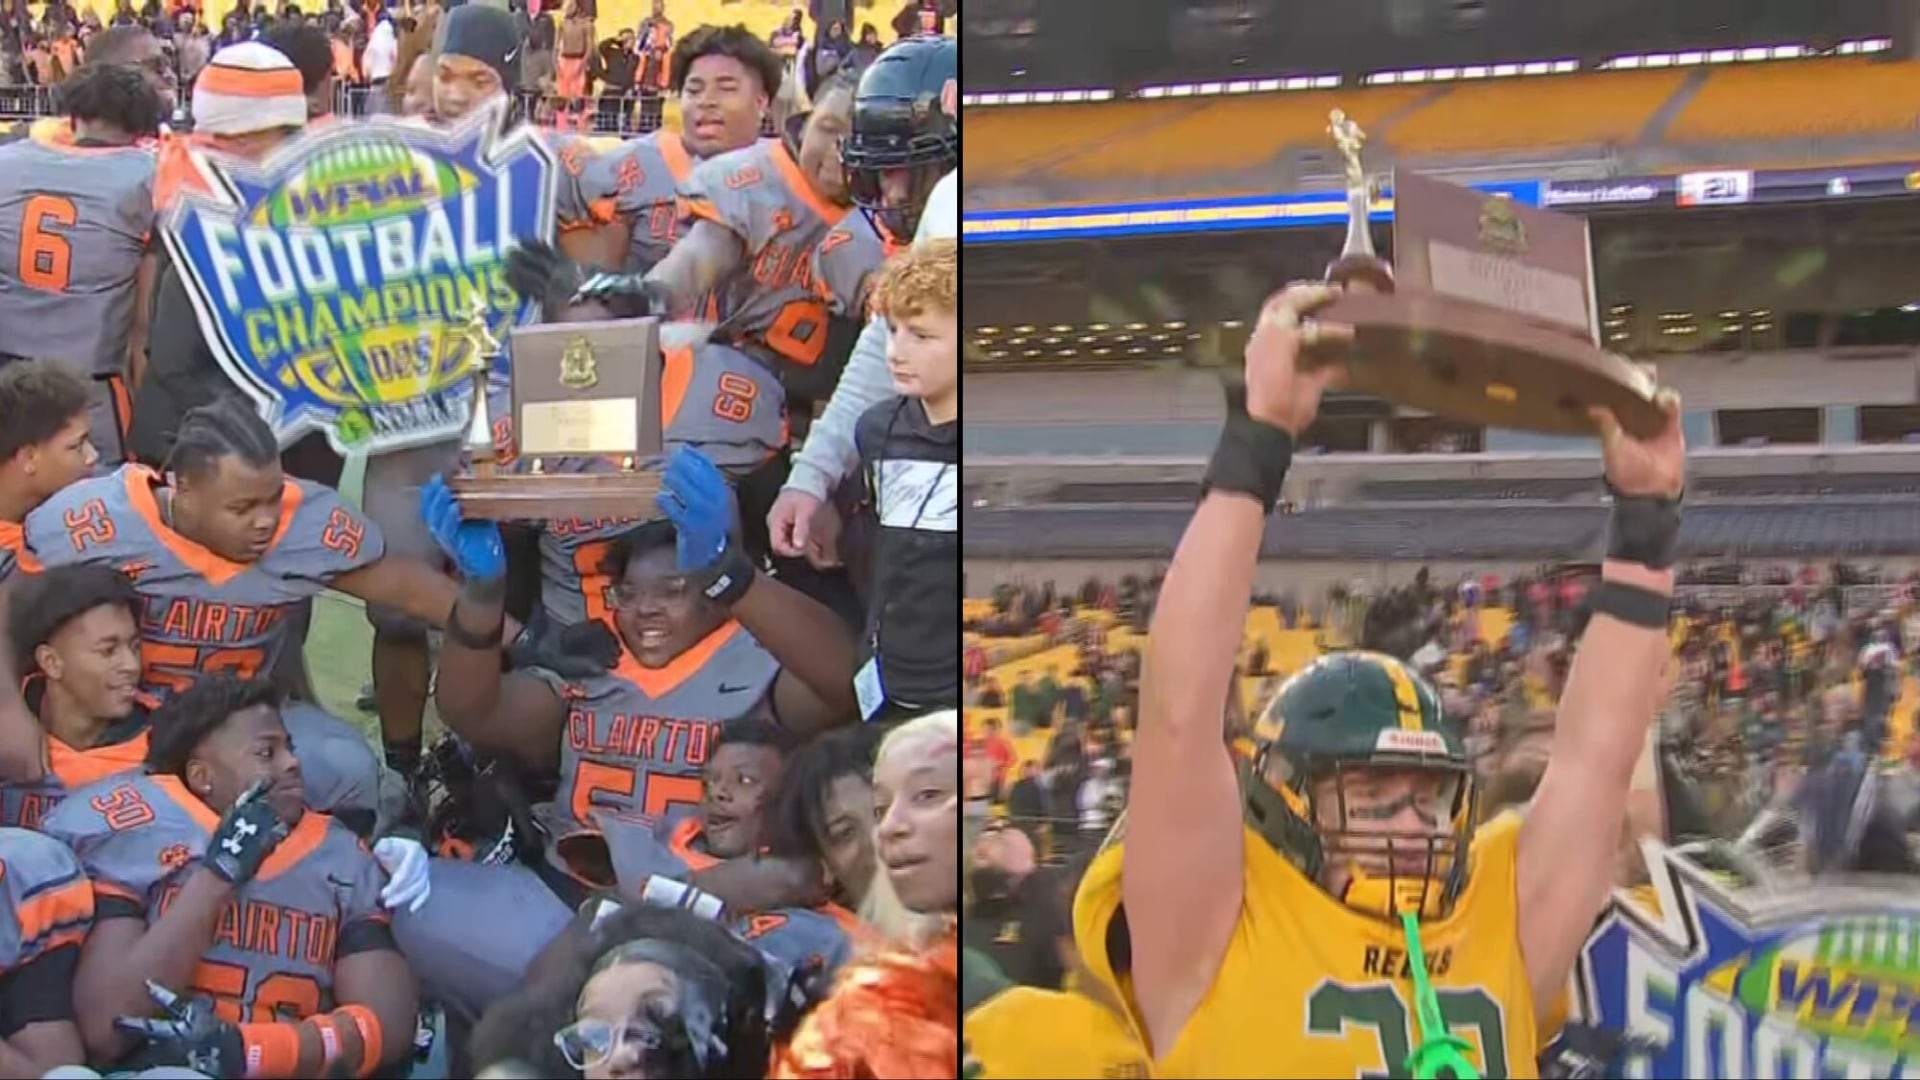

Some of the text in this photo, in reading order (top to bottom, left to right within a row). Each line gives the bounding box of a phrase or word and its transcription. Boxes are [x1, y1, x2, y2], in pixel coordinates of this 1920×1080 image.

[19, 195, 76, 292] 6
[203, 166, 524, 314] FOOTBALL
[244, 264, 520, 368] CHAMPIONS
[714, 371, 758, 422] 60
[64, 498, 118, 554] 52
[322, 506, 367, 559] 52
[140, 594, 290, 643] LAIRTO
[90, 783, 156, 832] 50
